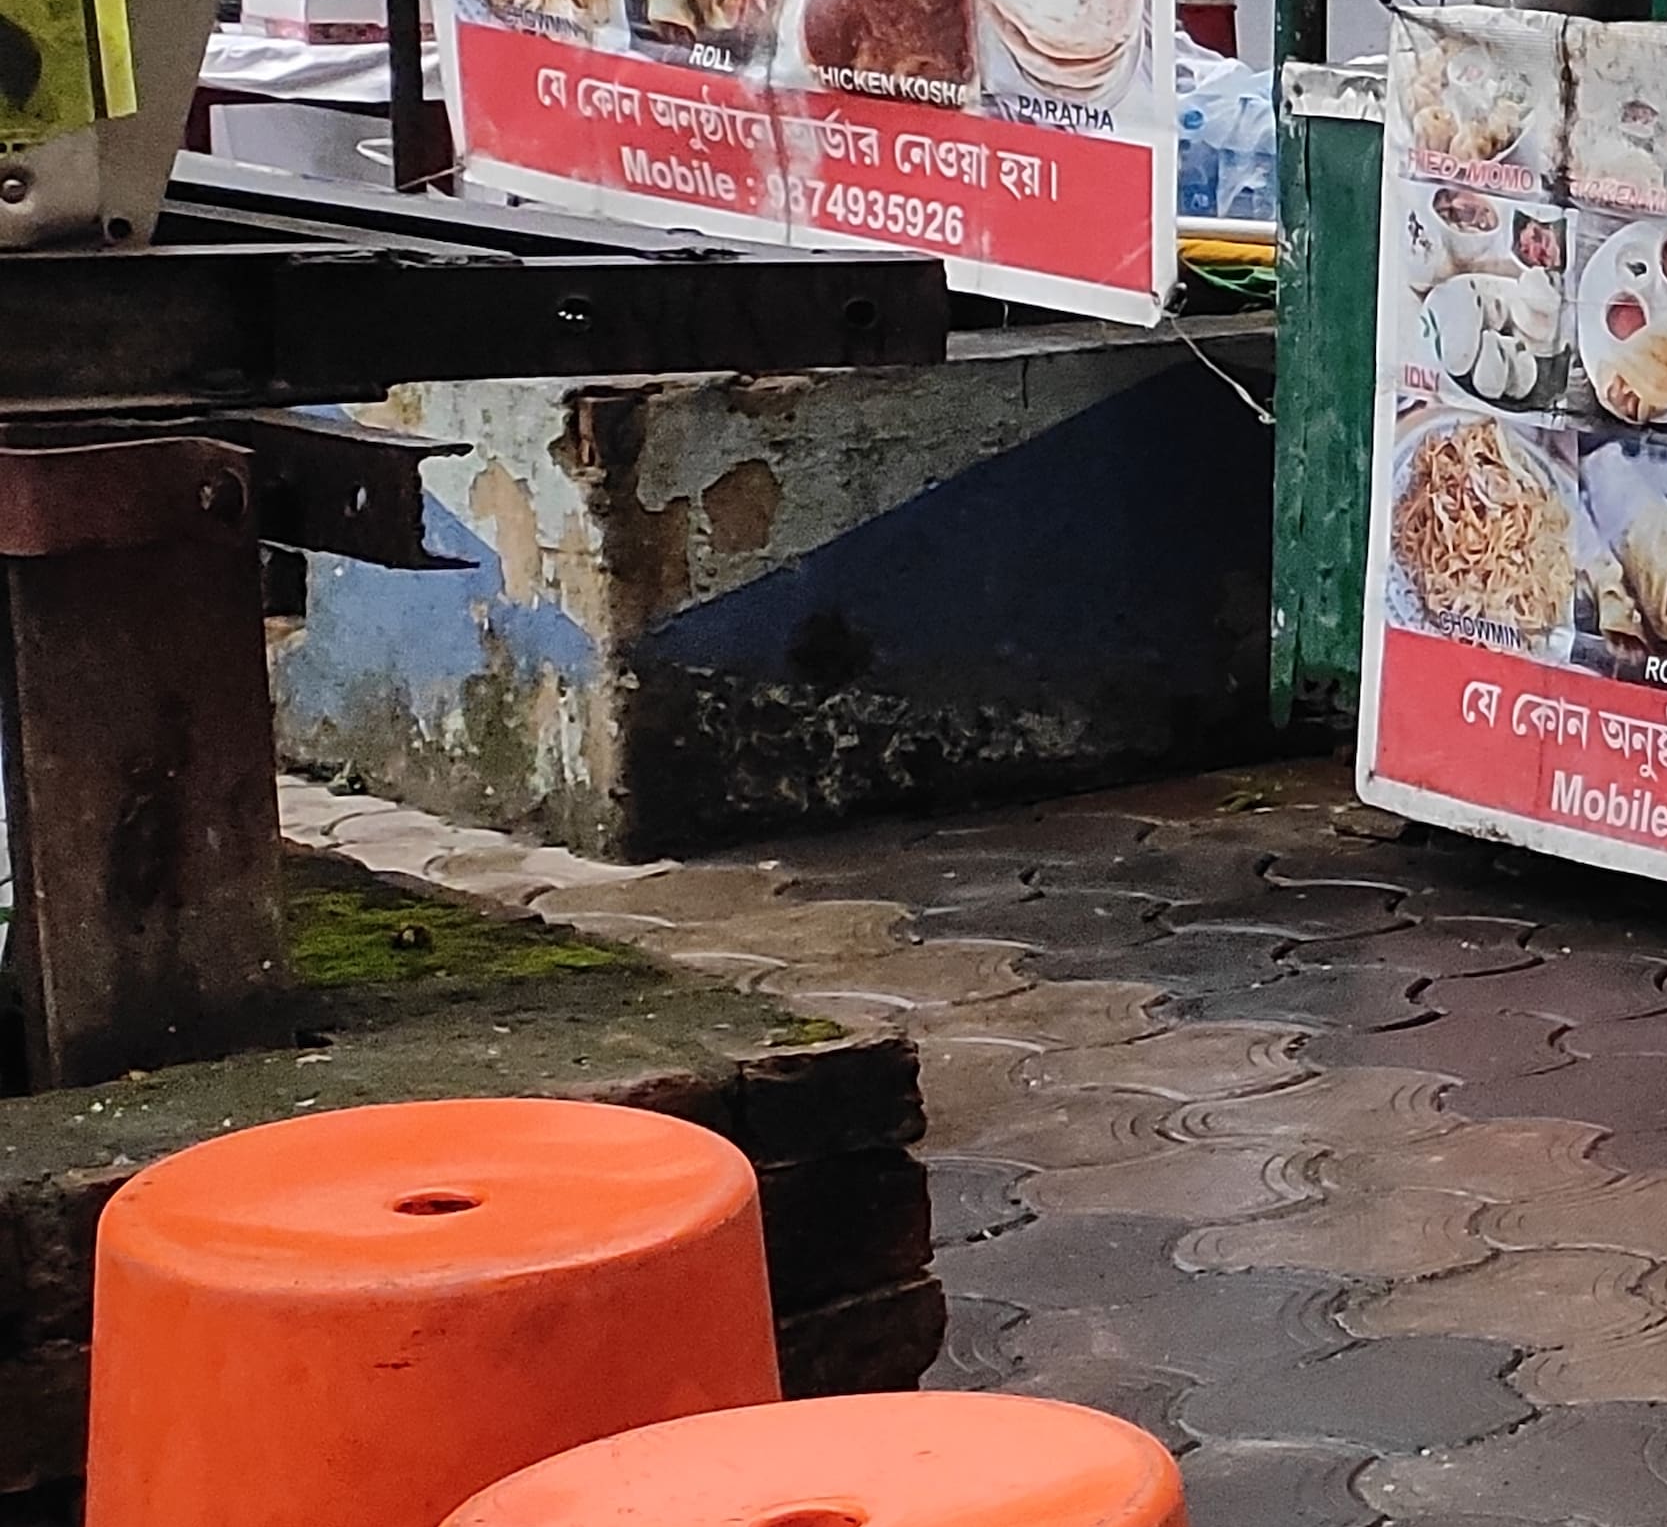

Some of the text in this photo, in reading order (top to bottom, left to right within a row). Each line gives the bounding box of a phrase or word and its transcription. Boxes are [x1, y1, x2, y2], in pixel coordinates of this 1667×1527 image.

[689, 43, 734, 73] ROLL
[899, 80, 969, 108] KOSHA
[537, 67, 566, 109] যে
[578, 79, 640, 126] কোন
[649, 86, 775, 154] অনুষ্ঠানে
[894, 133, 988, 191] নেওয়া
[1018, 95, 1115, 133] PARATHA
[1466, 159, 1534, 191] MOMO
[620, 145, 965, 245] Mobile 9874935926
[1404, 364, 1442, 393] IDLY
[1462, 679, 1502, 728] যে
[1512, 691, 1590, 751] কোন
